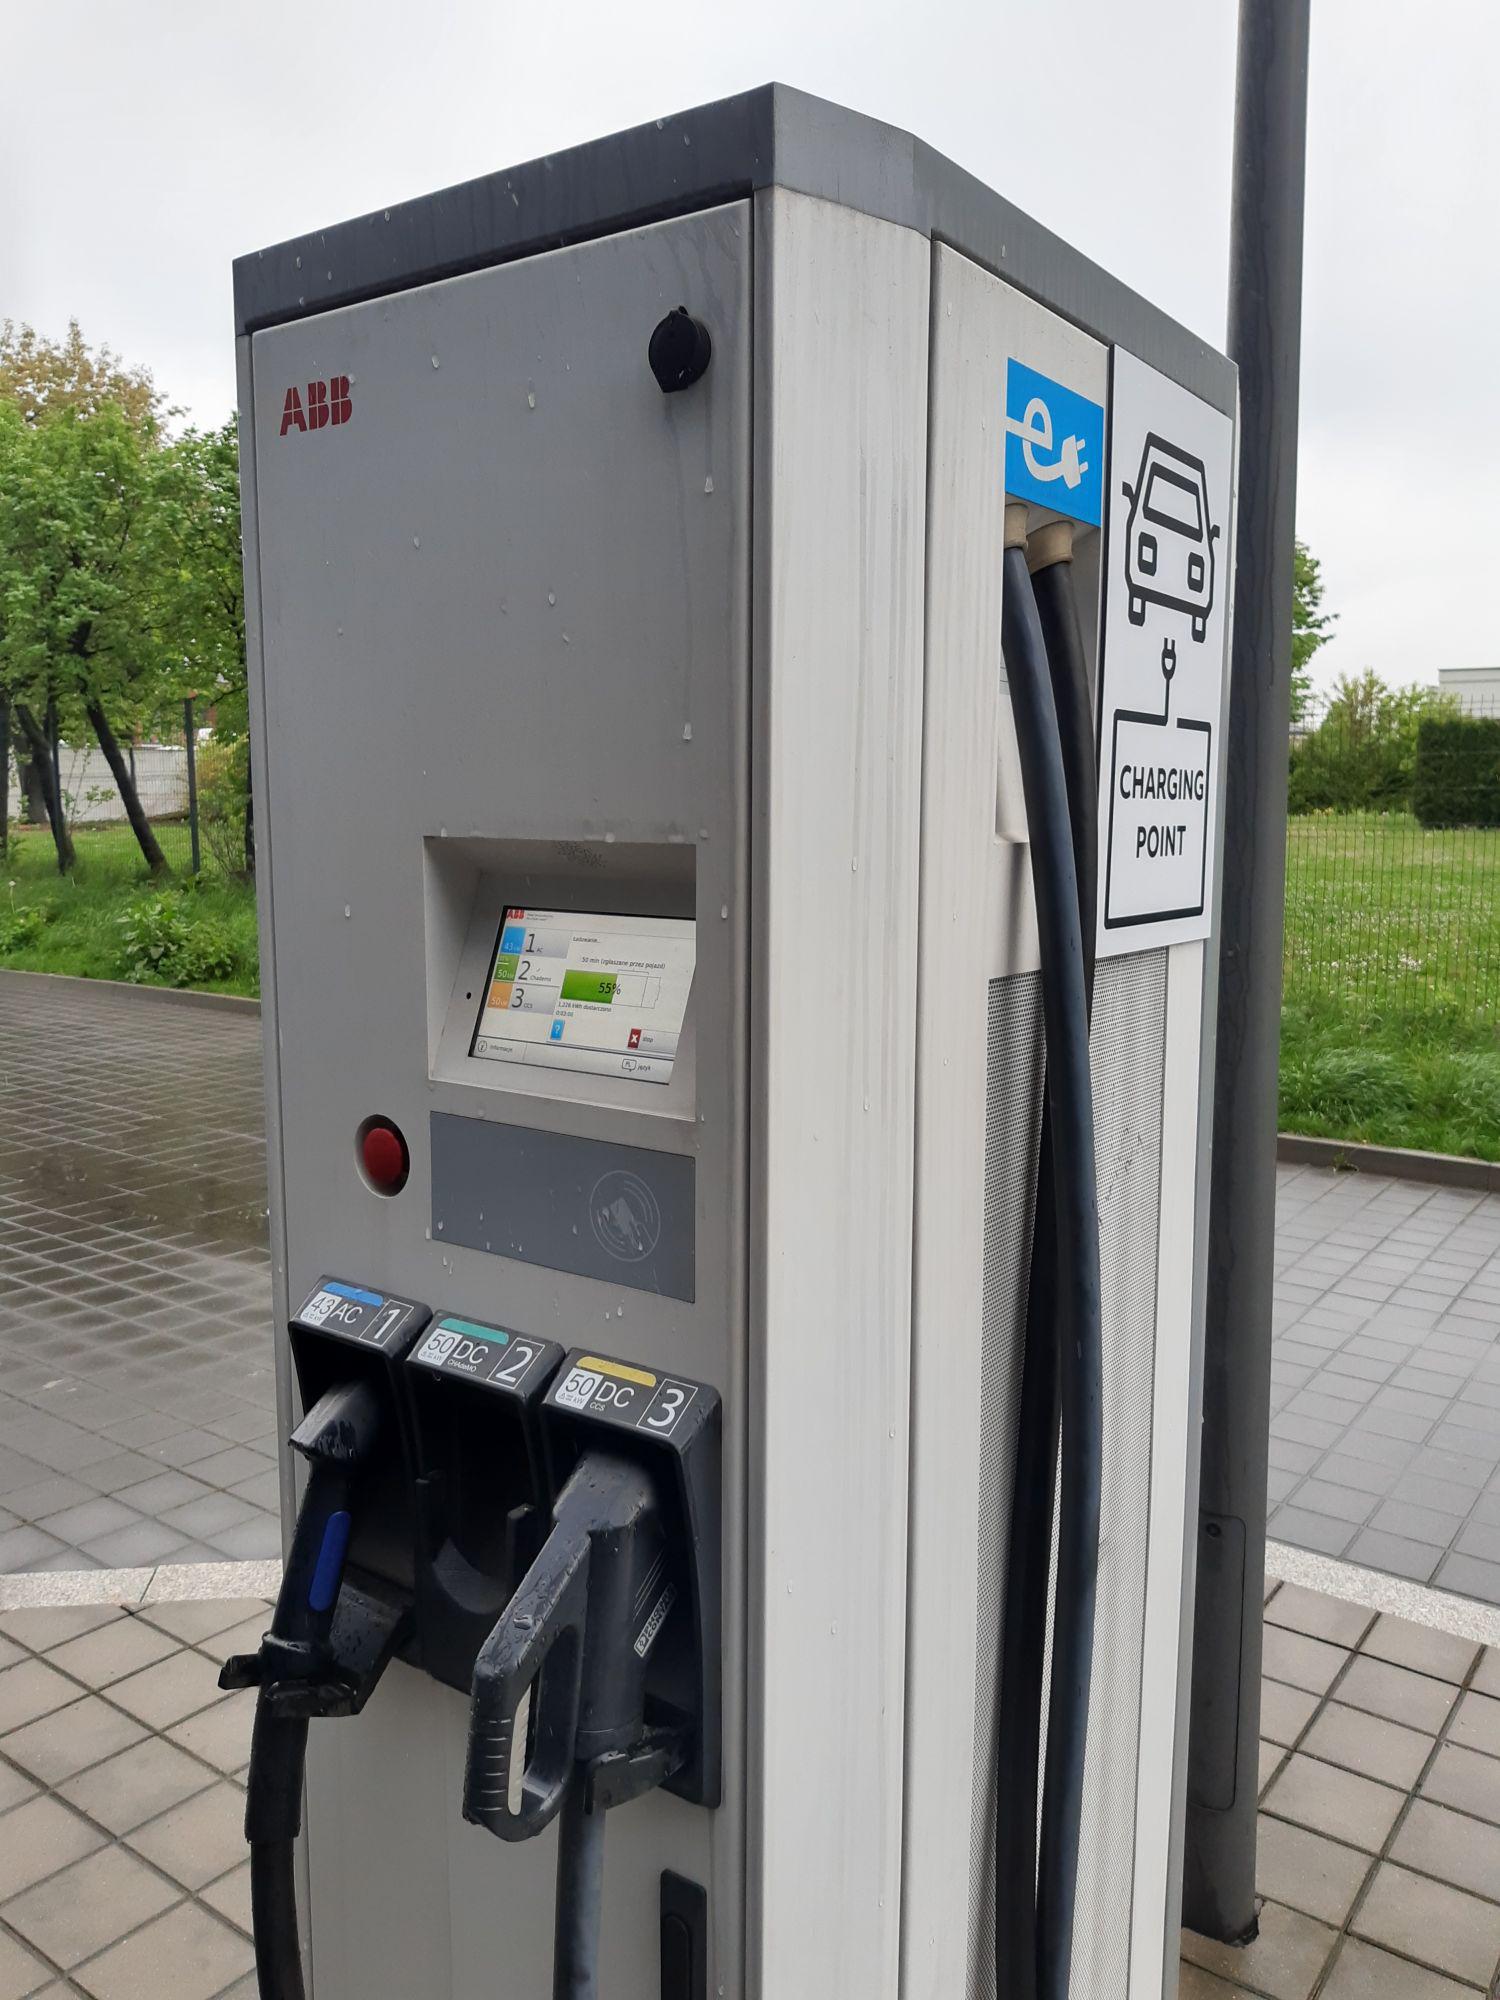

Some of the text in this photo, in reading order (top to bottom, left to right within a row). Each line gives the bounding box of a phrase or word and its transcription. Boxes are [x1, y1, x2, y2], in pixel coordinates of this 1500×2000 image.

[280, 376, 353, 436] ABB
[1120, 764, 1205, 801] CHARGING
[1136, 825, 1187, 859] POINT
[507, 909, 525, 920] ABB
[525, 933, 536, 953] 1
[497, 969, 508, 978] 50
[518, 960, 531, 981] 2
[591, 957, 600, 965] min
[629, 960, 644, 969] przez
[511, 988, 525, 1009] 3
[598, 982, 621, 995] 55%
[311, 1296, 363, 1324] 43 AC
[374, 1308, 401, 1339] 1
[428, 1333, 489, 1364] 50 DC
[495, 1346, 533, 1383] 2
[565, 1373, 635, 1408] 50 DC
[590, 1401, 606, 1412] CCS
[647, 1388, 685, 1427] 3
